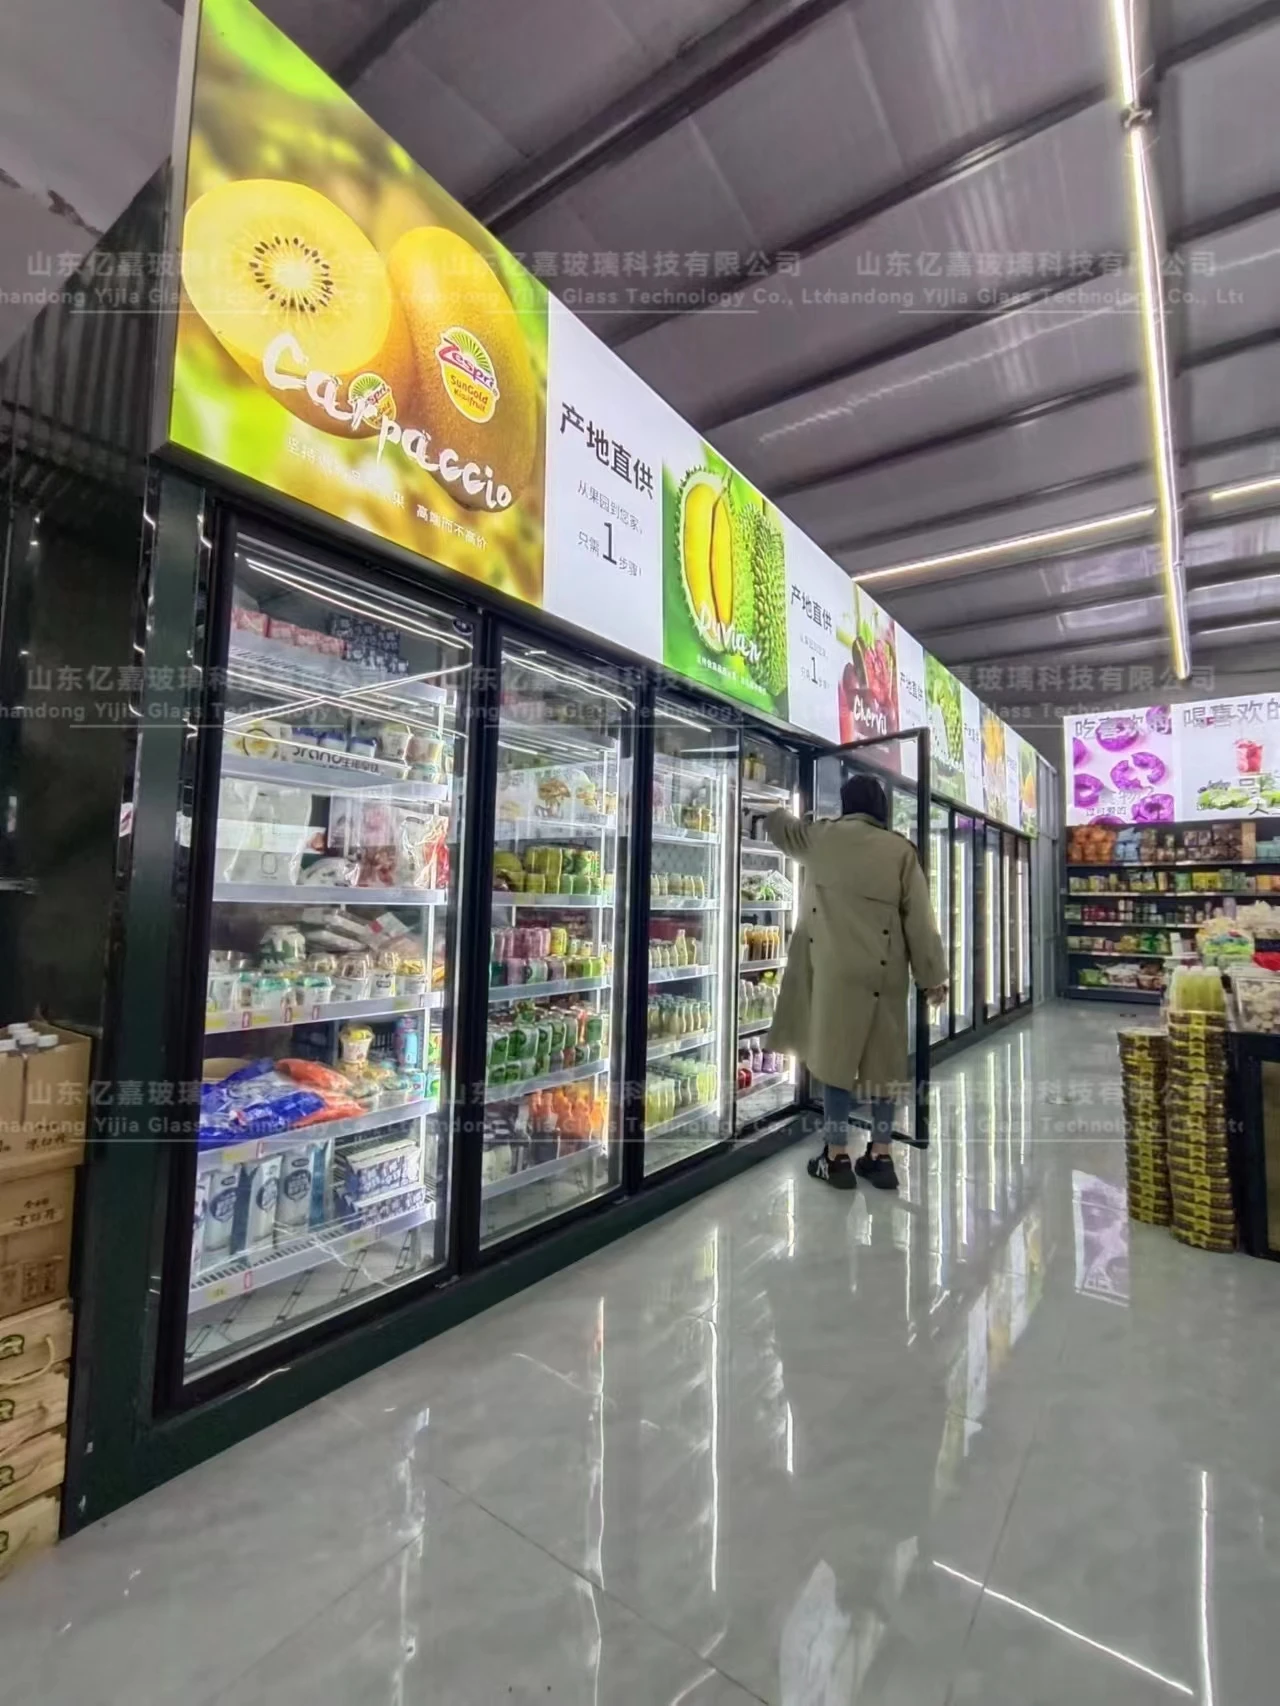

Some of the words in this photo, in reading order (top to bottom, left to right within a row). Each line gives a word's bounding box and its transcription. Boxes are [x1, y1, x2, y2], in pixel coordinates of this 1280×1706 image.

[438, 337, 495, 391] Zespri
[450, 374, 489, 405] SunGold
[262, 331, 513, 510] Carpaccio
[560, 401, 654, 500] 产地直供
[416, 503, 489, 553] 高端而不高价
[790, 584, 833, 635] 产地直供
